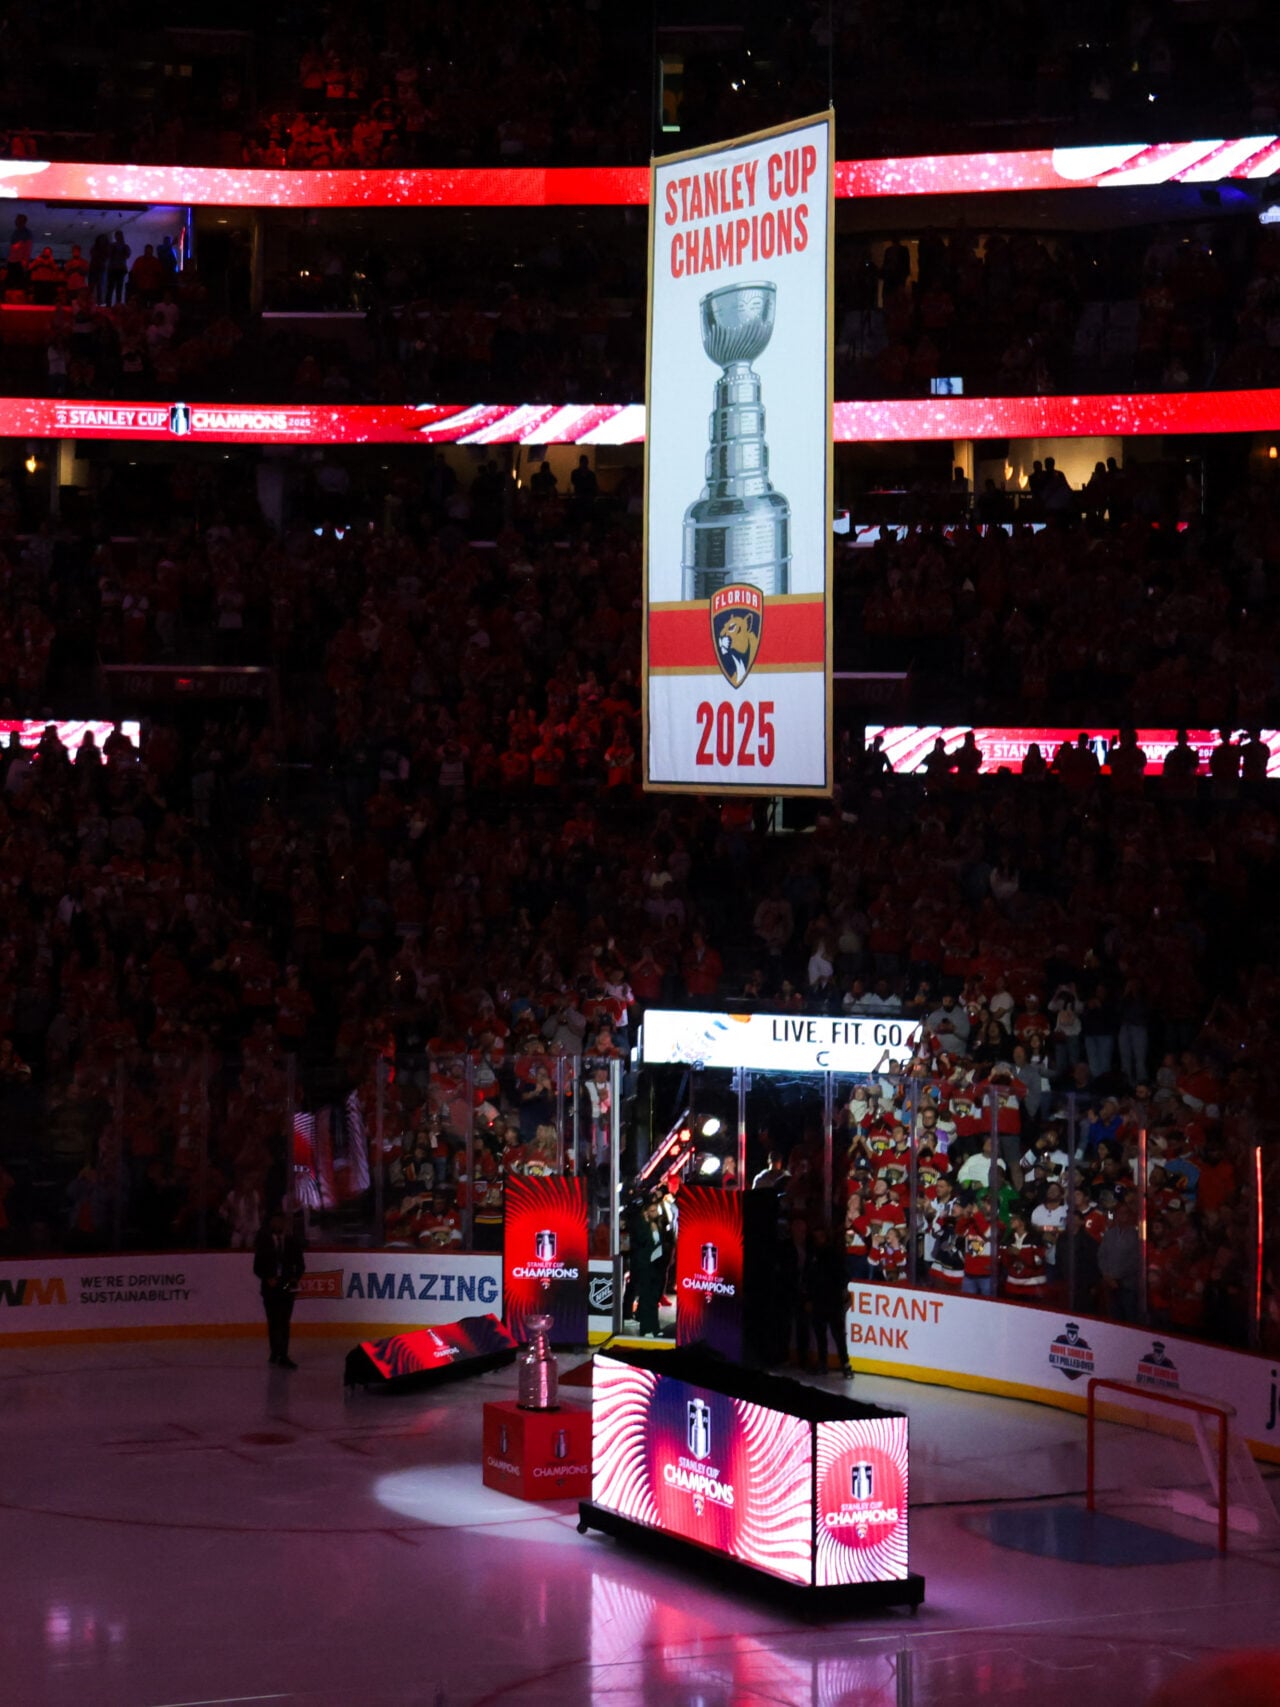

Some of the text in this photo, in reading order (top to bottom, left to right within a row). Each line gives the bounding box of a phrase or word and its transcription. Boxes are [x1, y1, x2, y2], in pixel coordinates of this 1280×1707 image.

[665, 145, 817, 226] STANLEY CUP
[670, 203, 809, 279] CHAMPIONS
[69, 410, 136, 426] STANLEY
[138, 411, 168, 426] CUP
[191, 412, 287, 430] CHAMPIONS
[715, 589, 758, 611] FLORIDA
[695, 700, 775, 768] 2025
[994, 744, 1056, 758] STANEY
[772, 1019, 823, 1044] LIVE.
[832, 1022, 865, 1045] FIT.
[80, 1273, 186, 1288] WE'RE DRIVING
[512, 1266, 579, 1278] CHAMPIONS
[80, 1288, 192, 1304] SUSTAINABILITY
[345, 1272, 499, 1304] AMAZING
[682, 1277, 735, 1296] CHAMPIONS
[850, 1290, 944, 1324] ERANT
[850, 1322, 910, 1350] BANK
[532, 1464, 589, 1478] CHAMPIONS
[678, 1456, 720, 1480] STANLEY CUP
[663, 1463, 734, 1505] CHAMPIONS
[825, 1507, 898, 1526] CHAMPIONS
[841, 1502, 869, 1512] STANLEY
